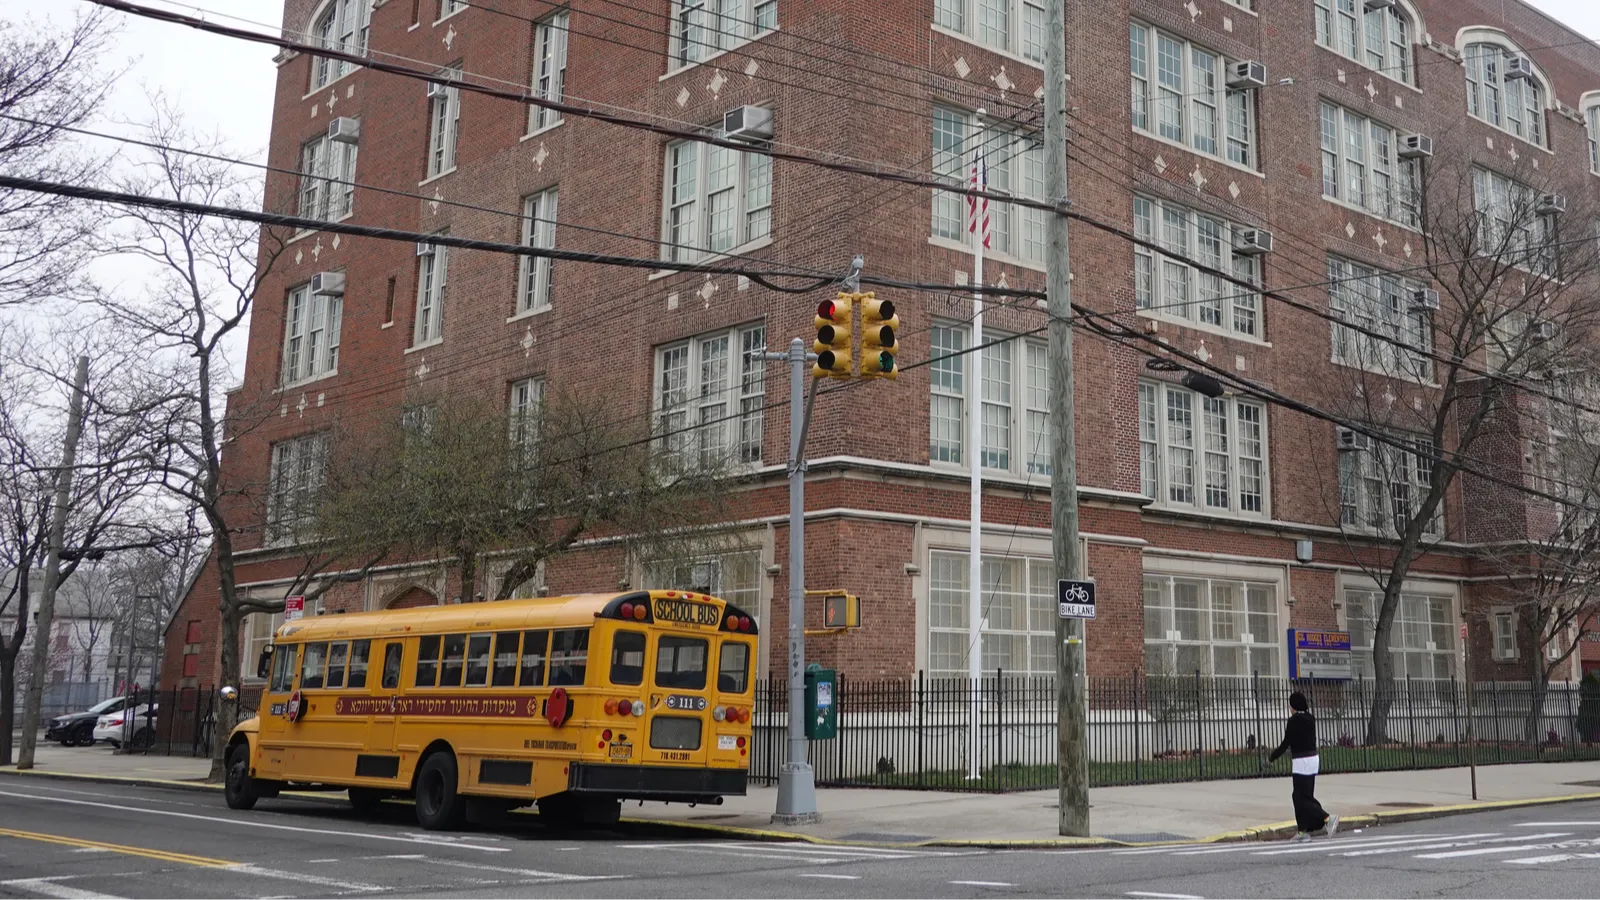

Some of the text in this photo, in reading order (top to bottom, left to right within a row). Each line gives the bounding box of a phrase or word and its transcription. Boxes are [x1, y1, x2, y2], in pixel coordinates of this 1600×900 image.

[656, 600, 717, 625] SCHOOL BUS
[1061, 604, 1094, 616] BIKE LANE
[450, 699, 479, 714] החינוך
[481, 699, 517, 714] מוסדות
[679, 697, 693, 709] 111
